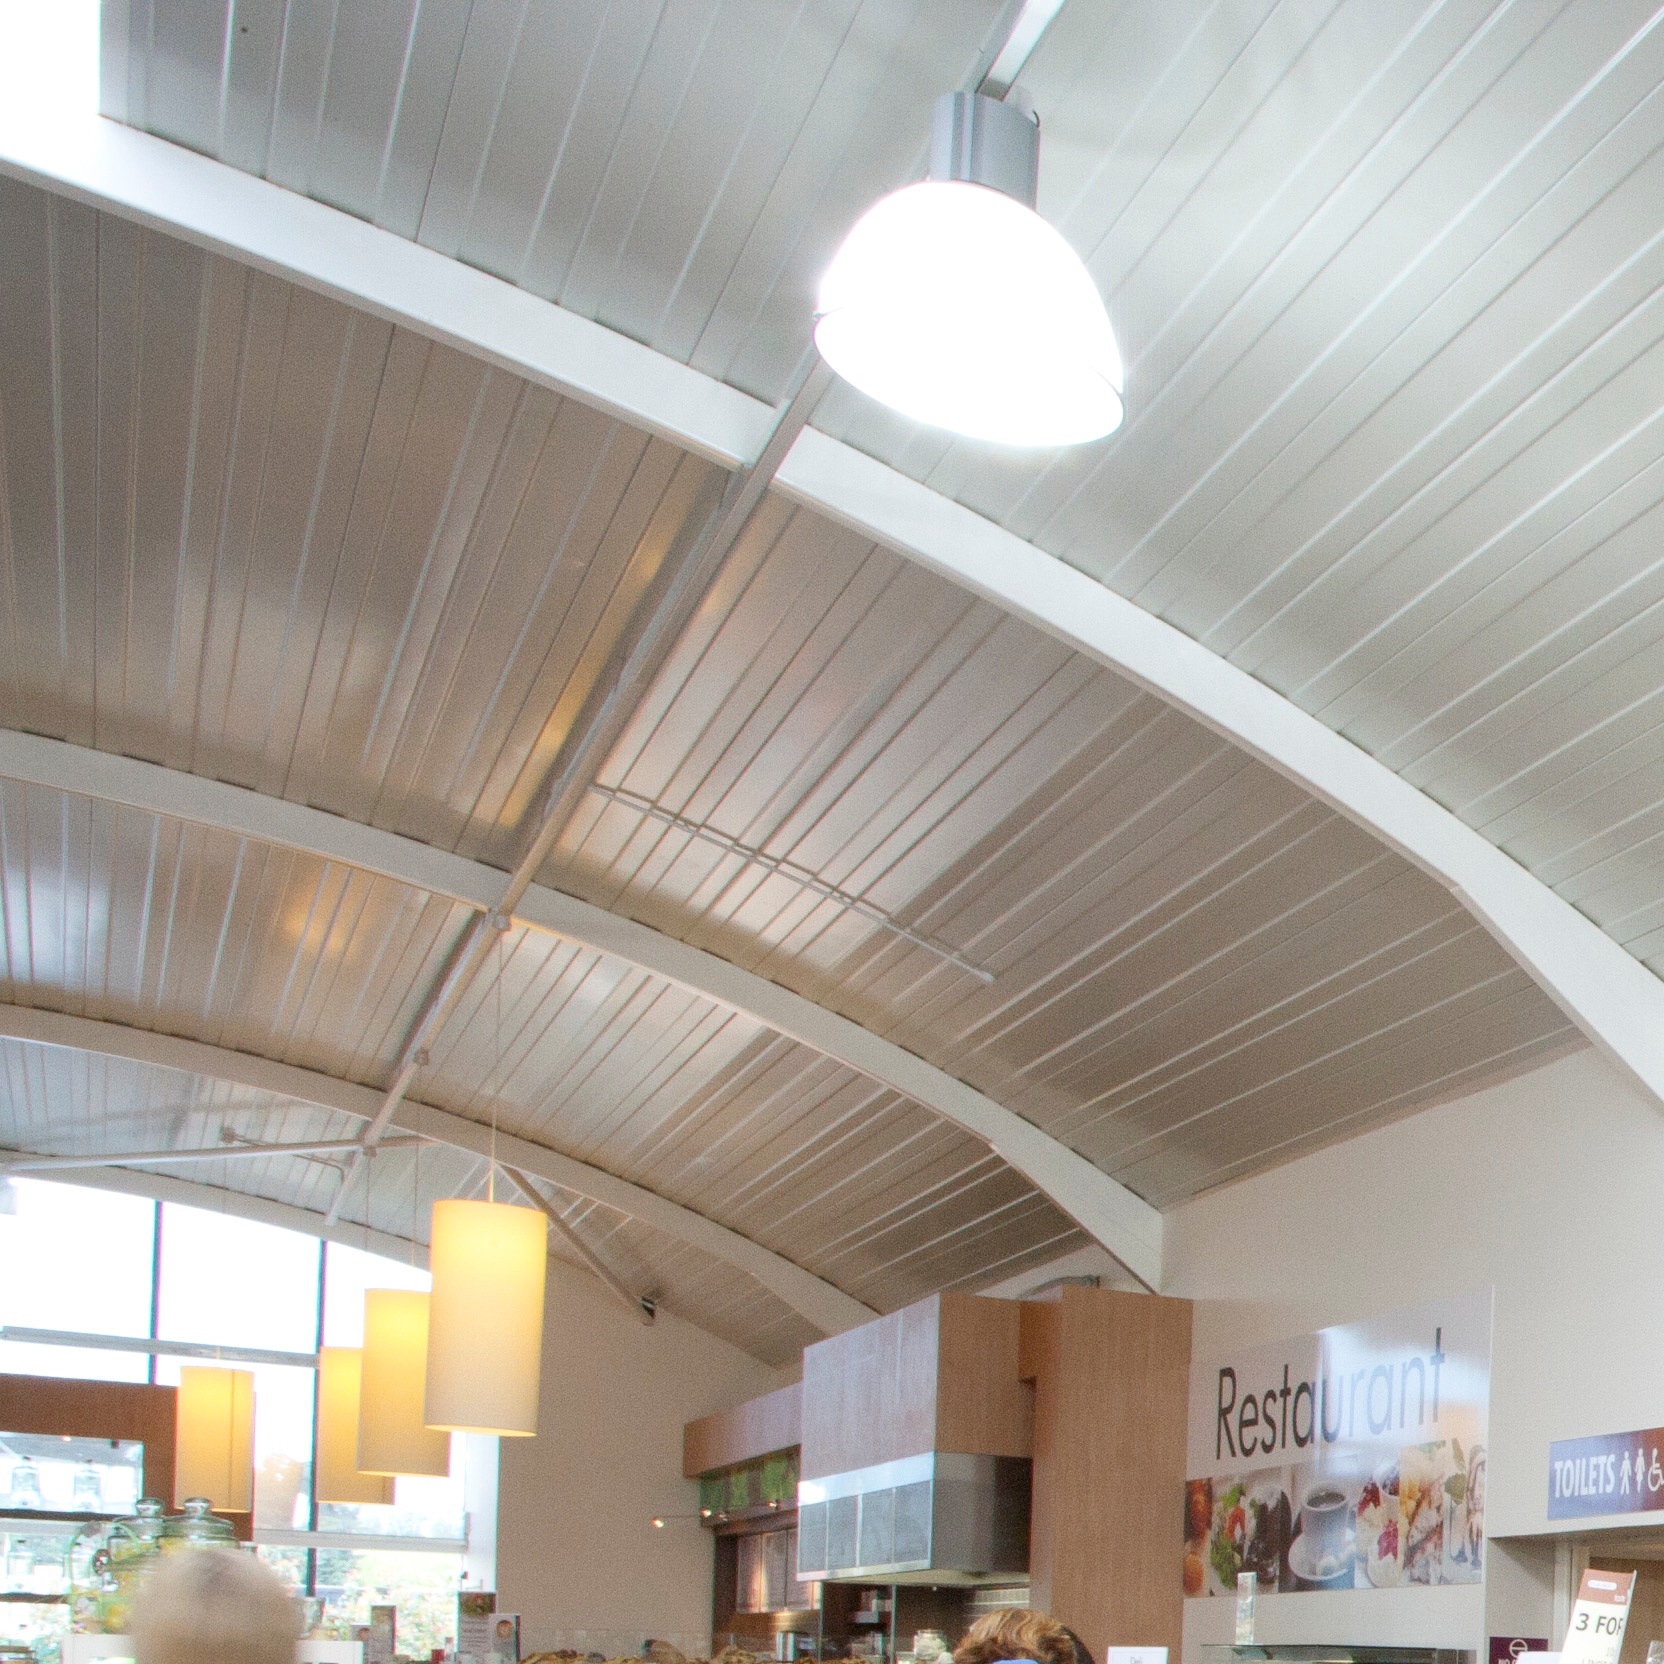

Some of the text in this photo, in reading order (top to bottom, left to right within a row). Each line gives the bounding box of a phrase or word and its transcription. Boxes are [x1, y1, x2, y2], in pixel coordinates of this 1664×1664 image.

[1216, 1327, 1445, 1460] Restaurant
[1554, 1453, 1616, 1499] TOILETS
[1576, 1613, 1589, 1631] 3
